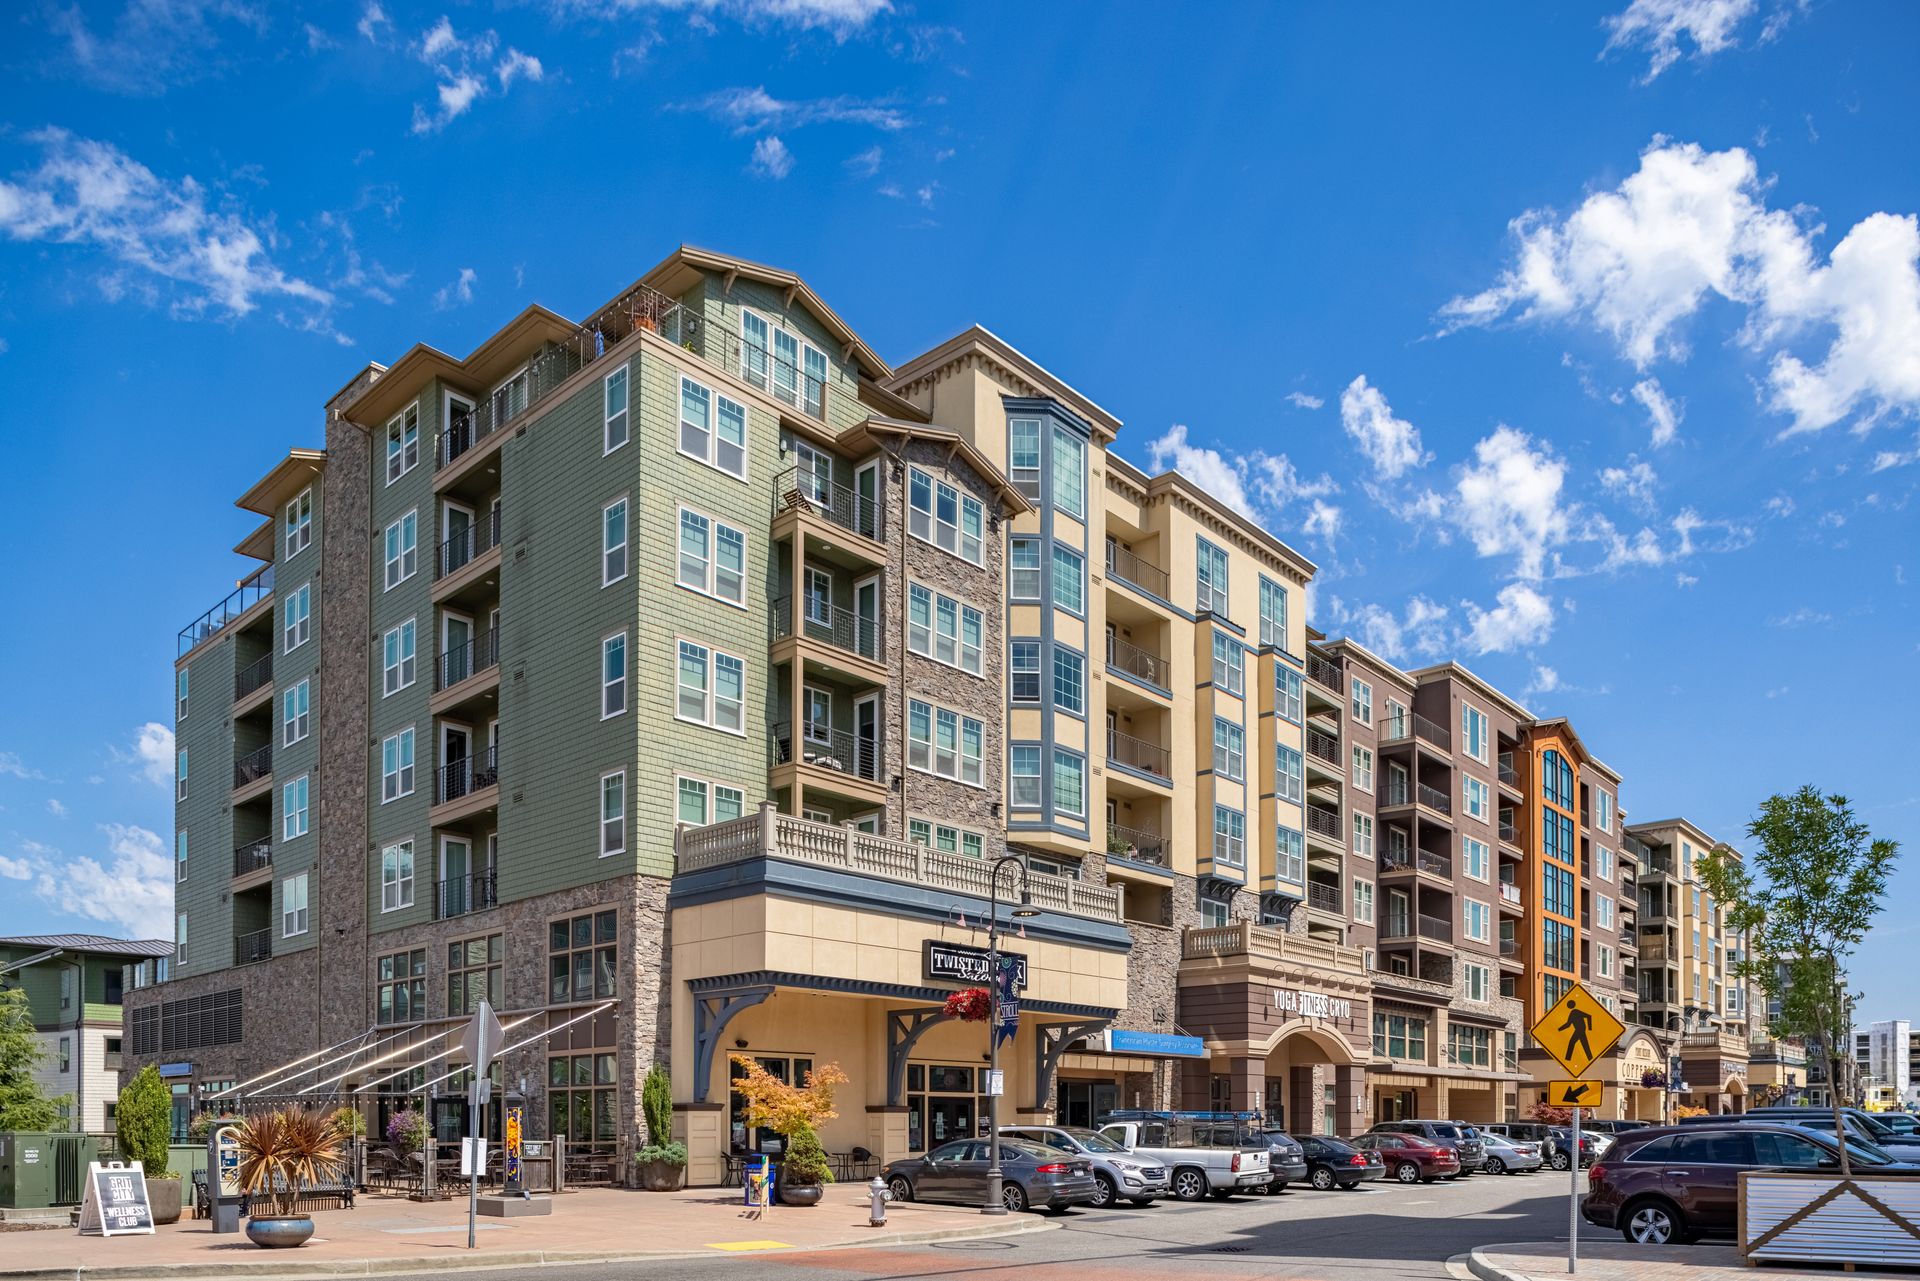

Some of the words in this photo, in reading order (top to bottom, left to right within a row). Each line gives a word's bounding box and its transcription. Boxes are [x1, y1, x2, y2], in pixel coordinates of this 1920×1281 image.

[934, 953, 989, 973] TWISTED
[1273, 989, 1297, 1012] YOGA
[1297, 992, 1329, 1016] FITNESS
[1329, 998, 1350, 1019] CRYO
[1000, 1003, 1019, 1018] STROLL
[110, 1177, 132, 1189] GRIT
[112, 1188, 134, 1200] CITY
[107, 1206, 146, 1218] WELLNESS
[118, 1216, 138, 1227] CLUB
